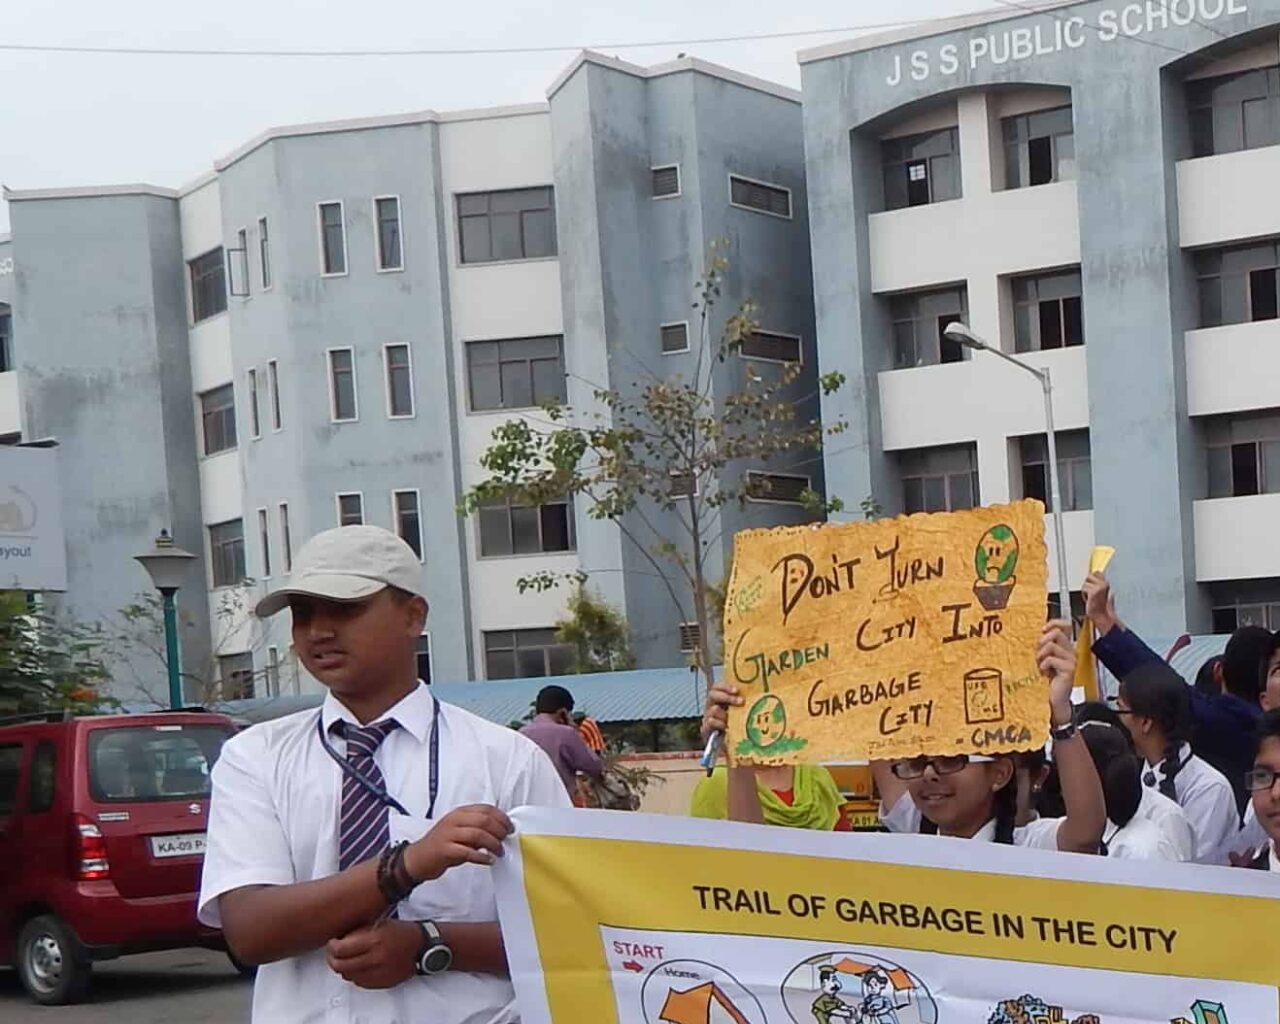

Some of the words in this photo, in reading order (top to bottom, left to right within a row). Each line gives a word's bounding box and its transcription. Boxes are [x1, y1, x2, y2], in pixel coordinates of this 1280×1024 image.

[886, 56, 901, 86] J
[911, 51, 929, 81] S
[938, 45, 959, 75] S
[969, 16, 1086, 69] PUBLIC
[1097, 0, 1248, 42] SCHOOL
[771, 553, 861, 626] DON'T
[807, 671, 923, 717] GARBAGE
[971, 724, 1032, 748] CMCA
[693, 885, 781, 917] TRAIL
[787, 893, 825, 919] OF
[835, 899, 985, 936] GARBAGE
[993, 913, 1024, 941] IN
[1031, 916, 1097, 947] THE
[1105, 921, 1177, 954] CITY
[613, 940, 665, 960] START
[665, 966, 701, 980] Home
